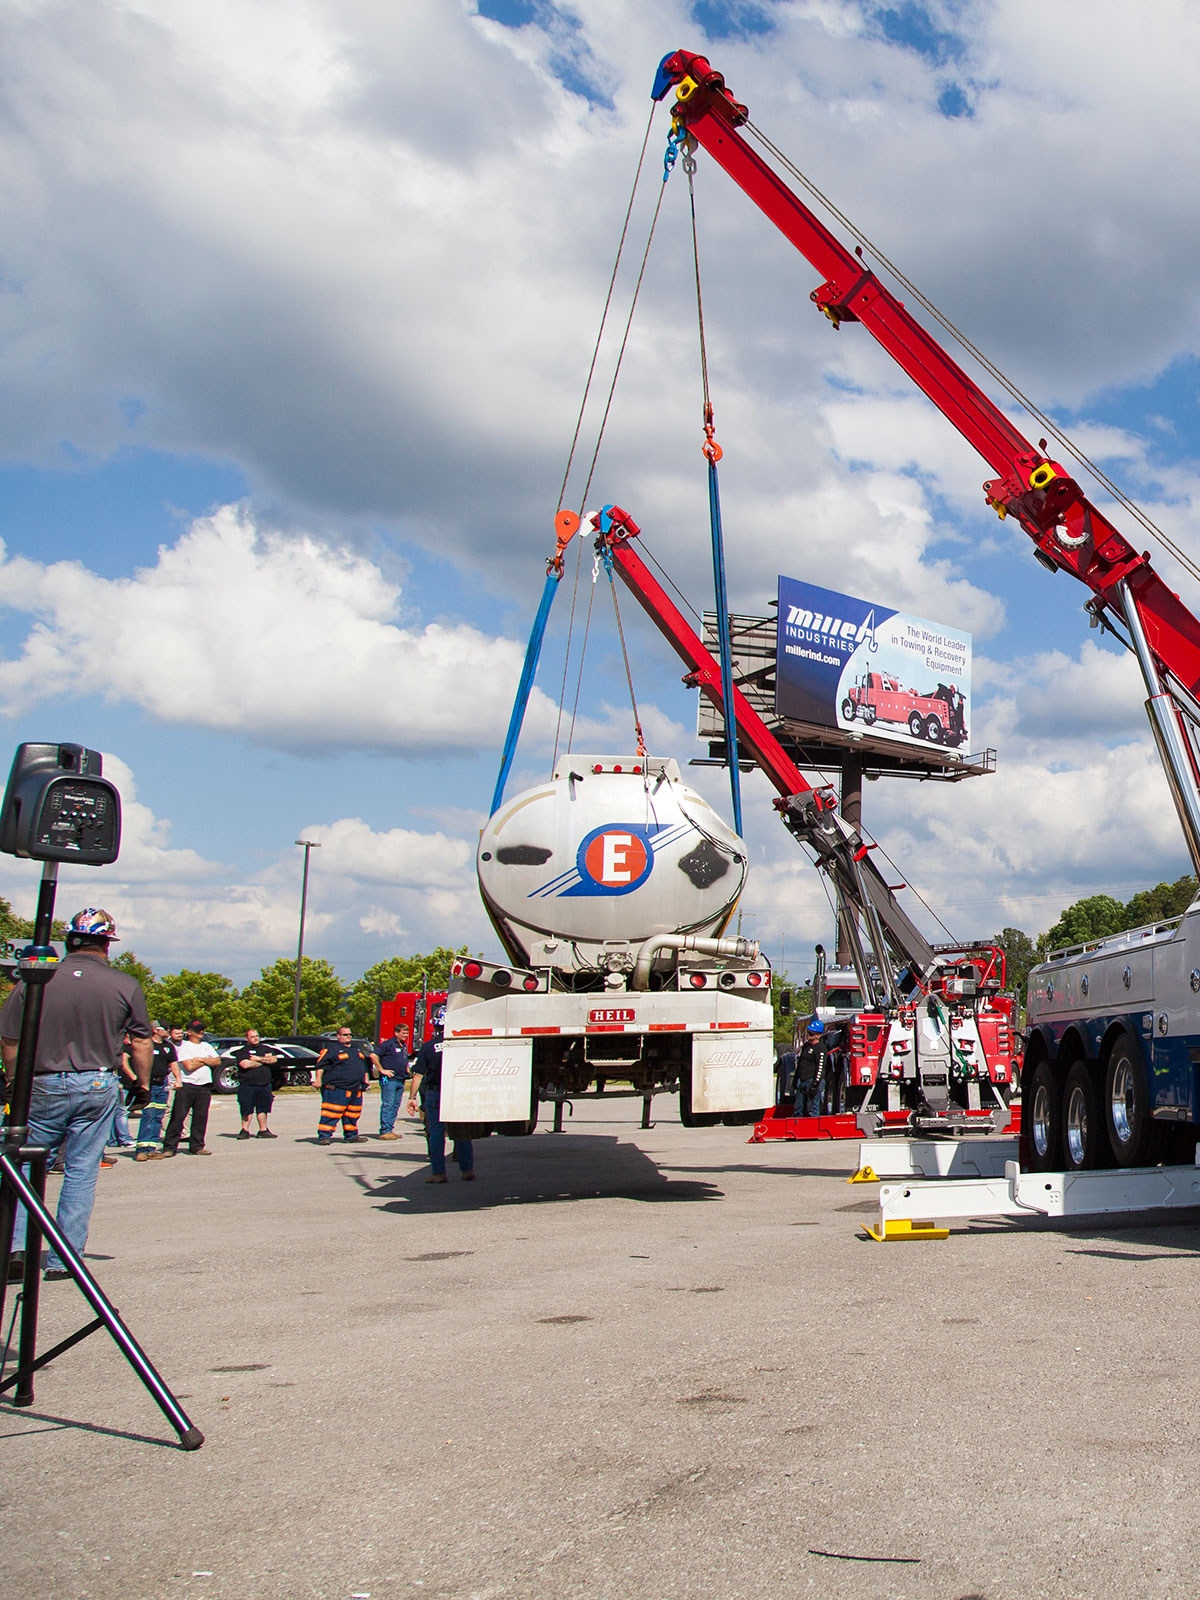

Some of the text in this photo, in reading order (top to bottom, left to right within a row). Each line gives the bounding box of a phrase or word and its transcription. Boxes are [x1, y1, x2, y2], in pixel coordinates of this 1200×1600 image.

[785, 625, 855, 653] INDUSTRIES
[787, 605, 878, 651] miller
[907, 625, 966, 652] The World Leader
[785, 644, 841, 666] millerind.com
[891, 634, 966, 666] in Towing & Recovery
[926, 657, 962, 676] Equipment
[601, 835, 632, 881] E
[595, 1010, 630, 1020] HEIL
